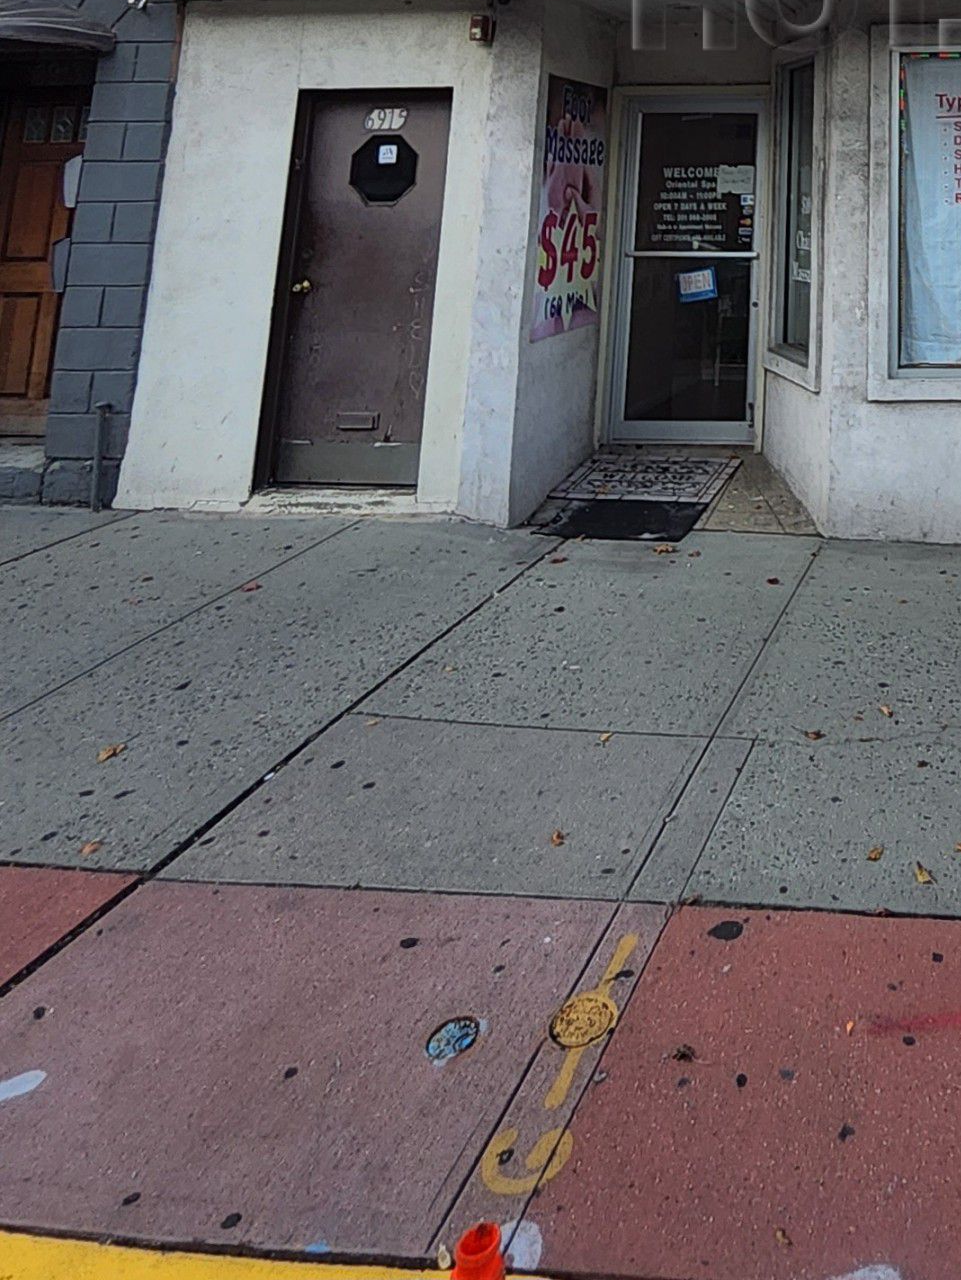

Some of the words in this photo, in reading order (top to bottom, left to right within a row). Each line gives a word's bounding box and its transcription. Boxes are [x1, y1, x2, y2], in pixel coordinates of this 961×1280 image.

[544, 127, 604, 167] Massage
[662, 167, 720, 178] WELCOME
[665, 180, 698, 188] Oriental
[537, 209, 598, 292] $45
